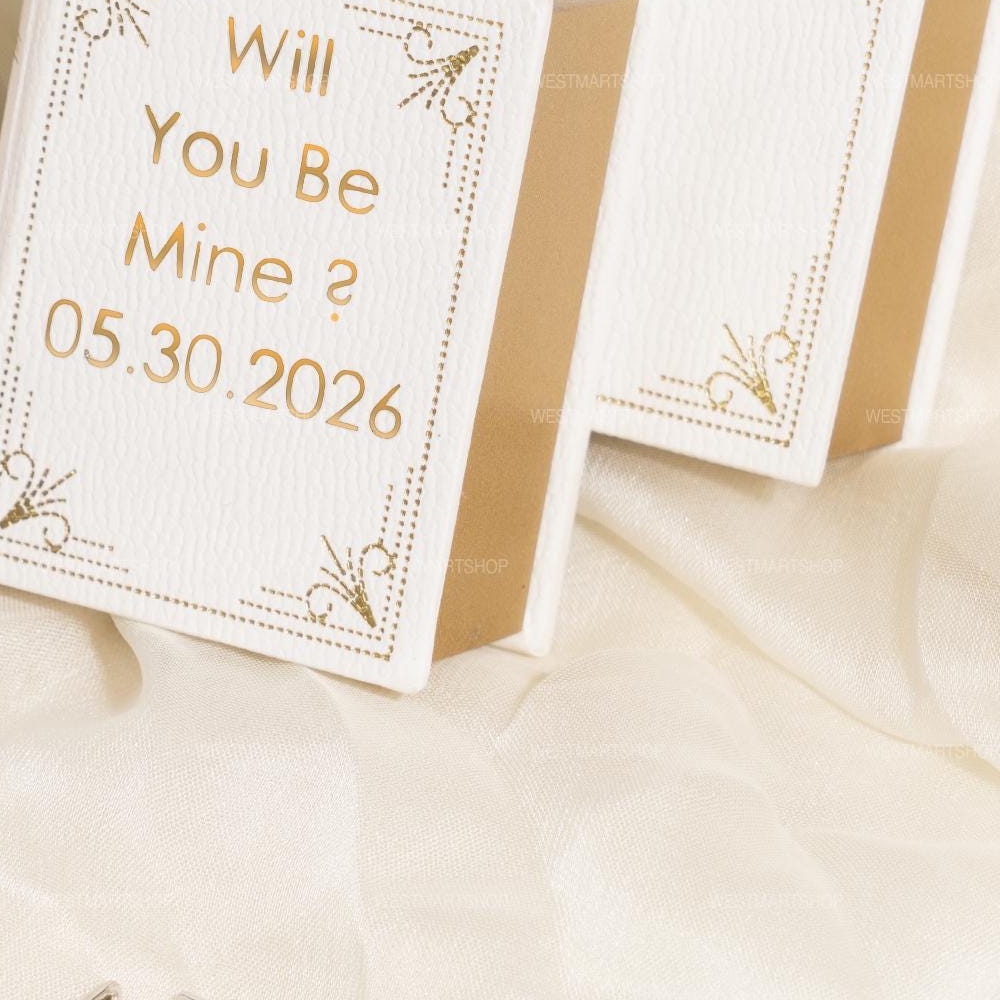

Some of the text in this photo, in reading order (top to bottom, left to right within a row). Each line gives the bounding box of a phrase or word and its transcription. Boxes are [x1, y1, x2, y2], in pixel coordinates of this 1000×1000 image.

[228, 15, 334, 96] Will
[144, 104, 380, 215] You Be
[123, 211, 293, 303] Mine
[44, 298, 402, 440] 05.30.2026
